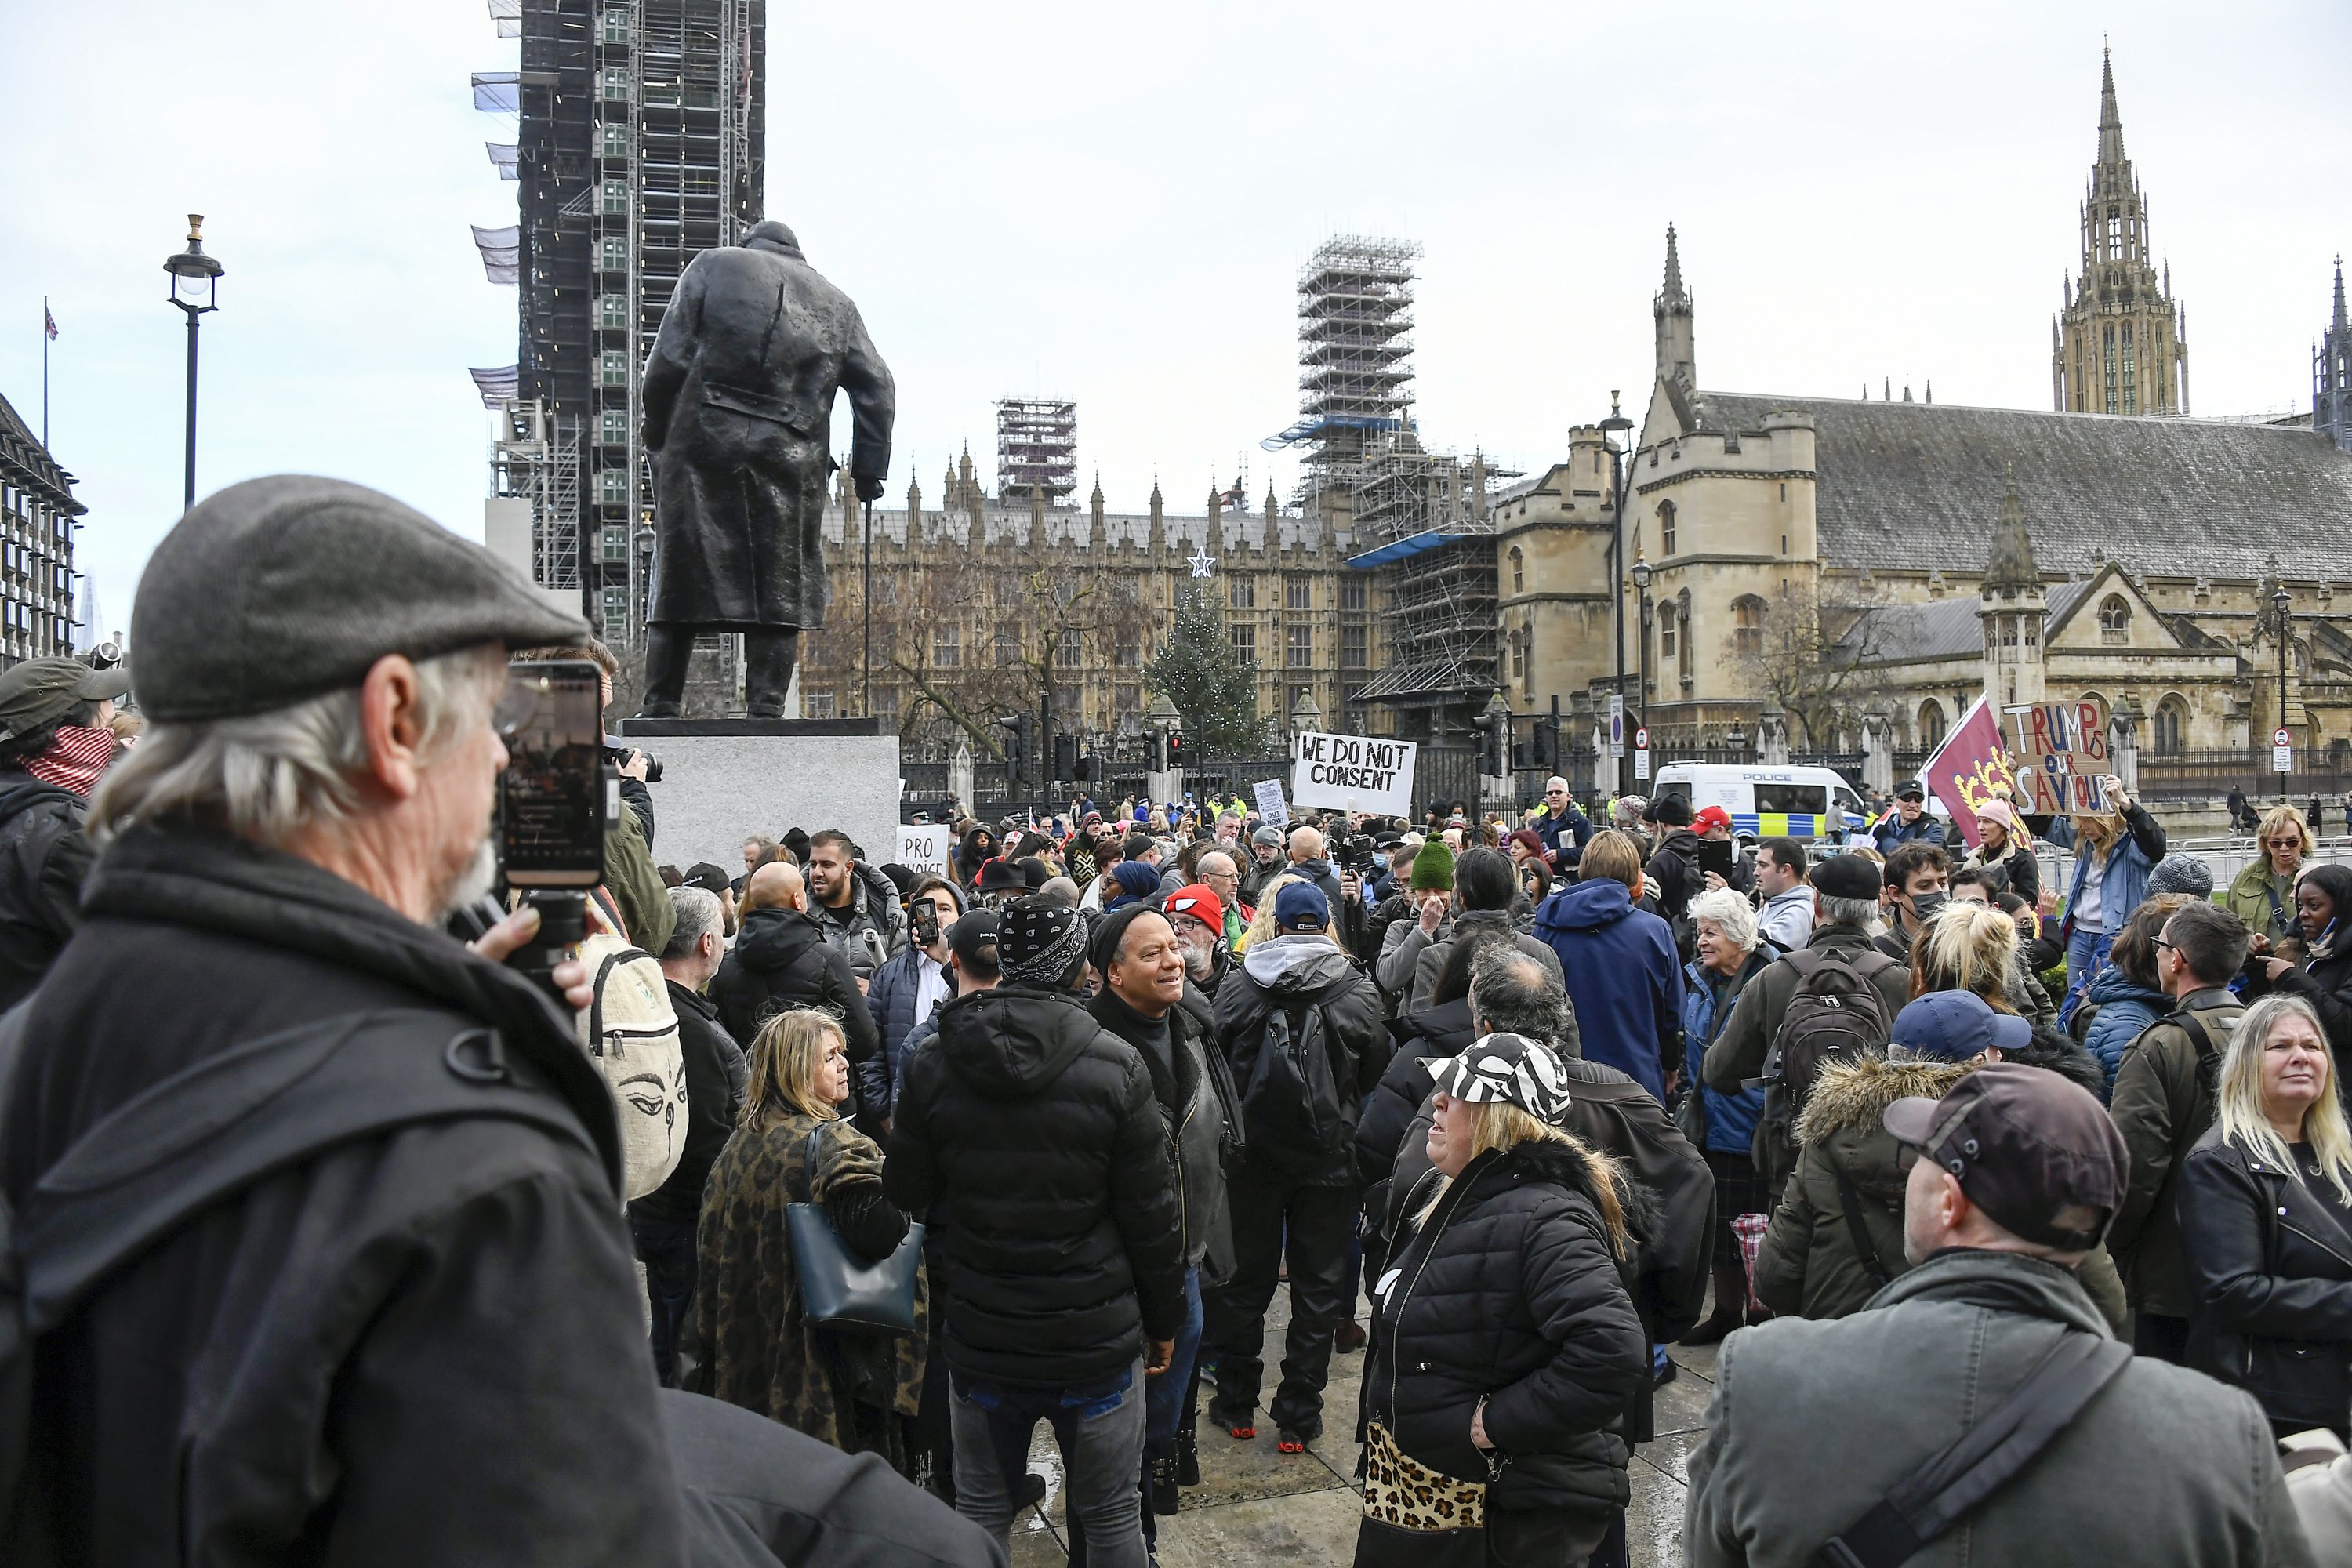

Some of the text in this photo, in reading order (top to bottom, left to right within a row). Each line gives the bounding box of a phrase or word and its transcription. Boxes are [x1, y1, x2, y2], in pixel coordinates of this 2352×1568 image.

[1302, 735, 1410, 770] WE DO NOT
[2045, 754, 2078, 775] OUR
[1311, 764, 1396, 791] CONSENT
[2016, 766, 2115, 815] SAVIOUR
[906, 838, 933, 858] PRO
